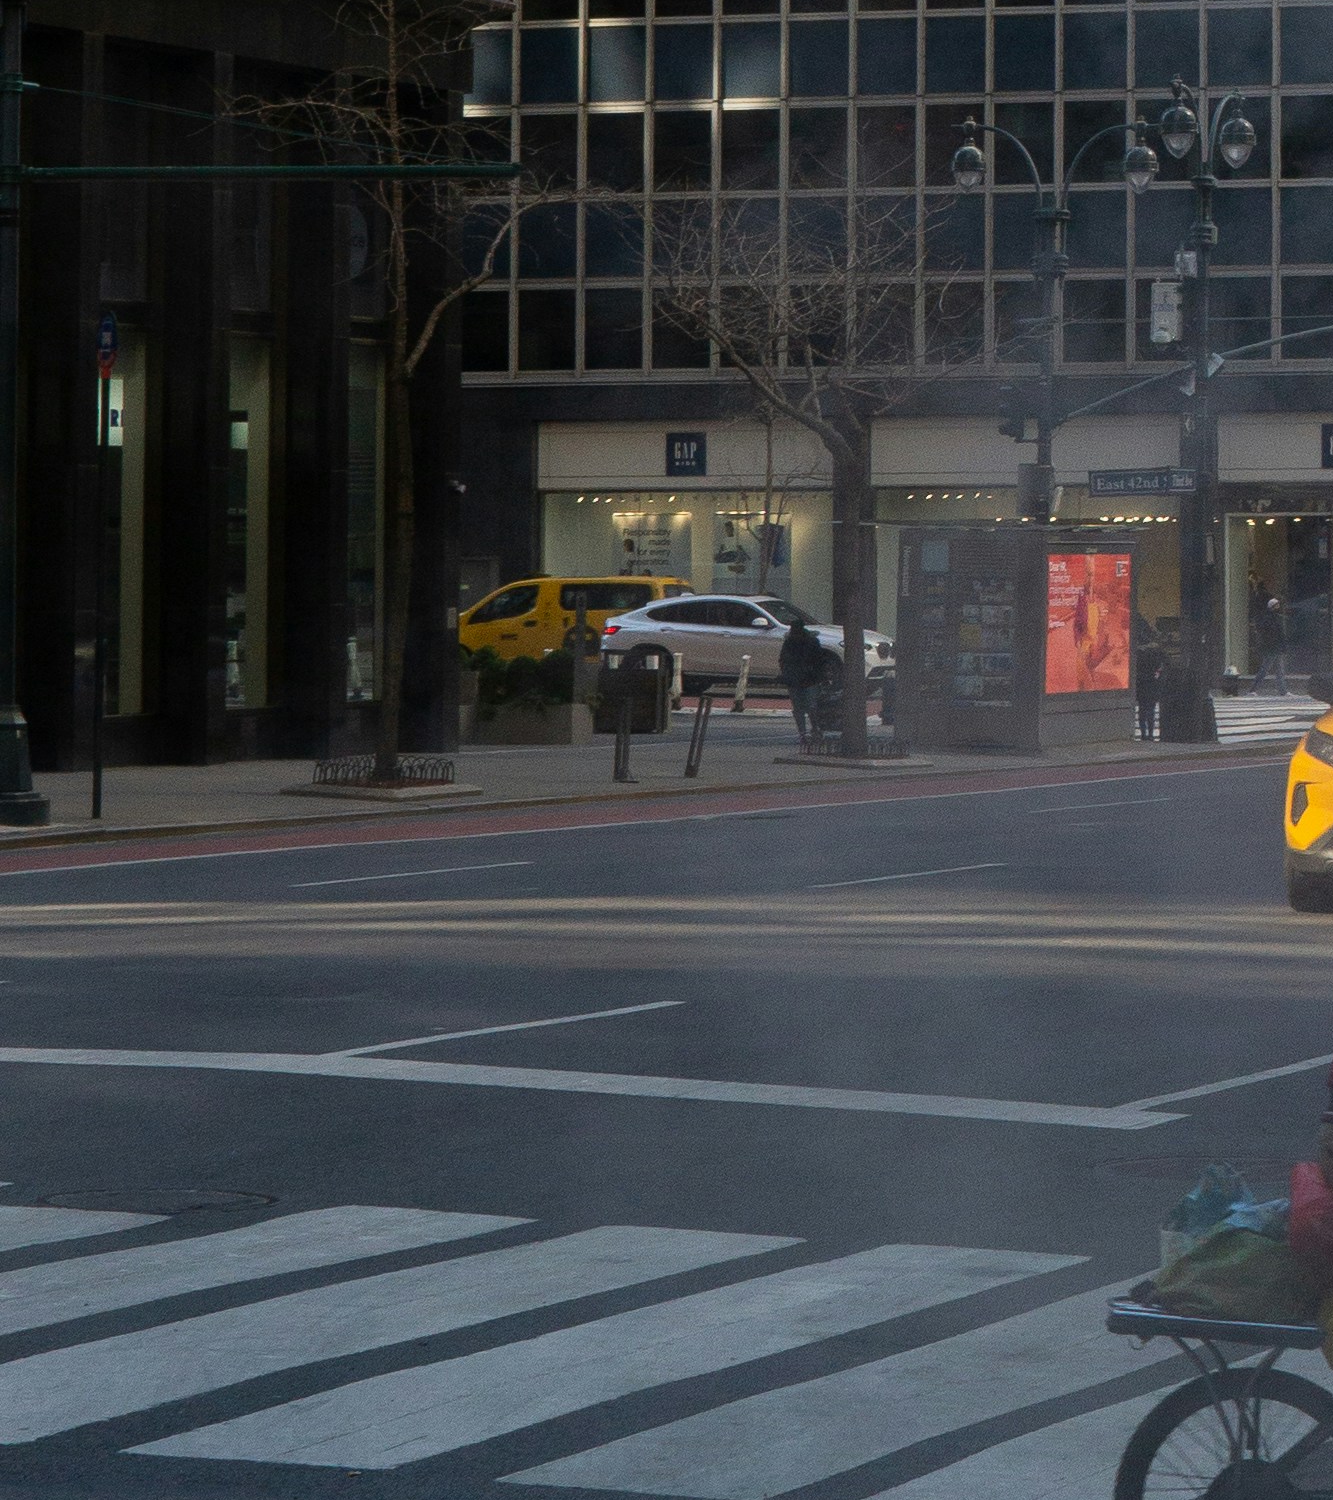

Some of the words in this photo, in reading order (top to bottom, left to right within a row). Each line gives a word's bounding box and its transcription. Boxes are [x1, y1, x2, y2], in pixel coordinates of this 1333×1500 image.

[674, 442, 697, 459] GAP
[1096, 477, 1125, 490] East
[1128, 476, 1160, 488] 42nd
